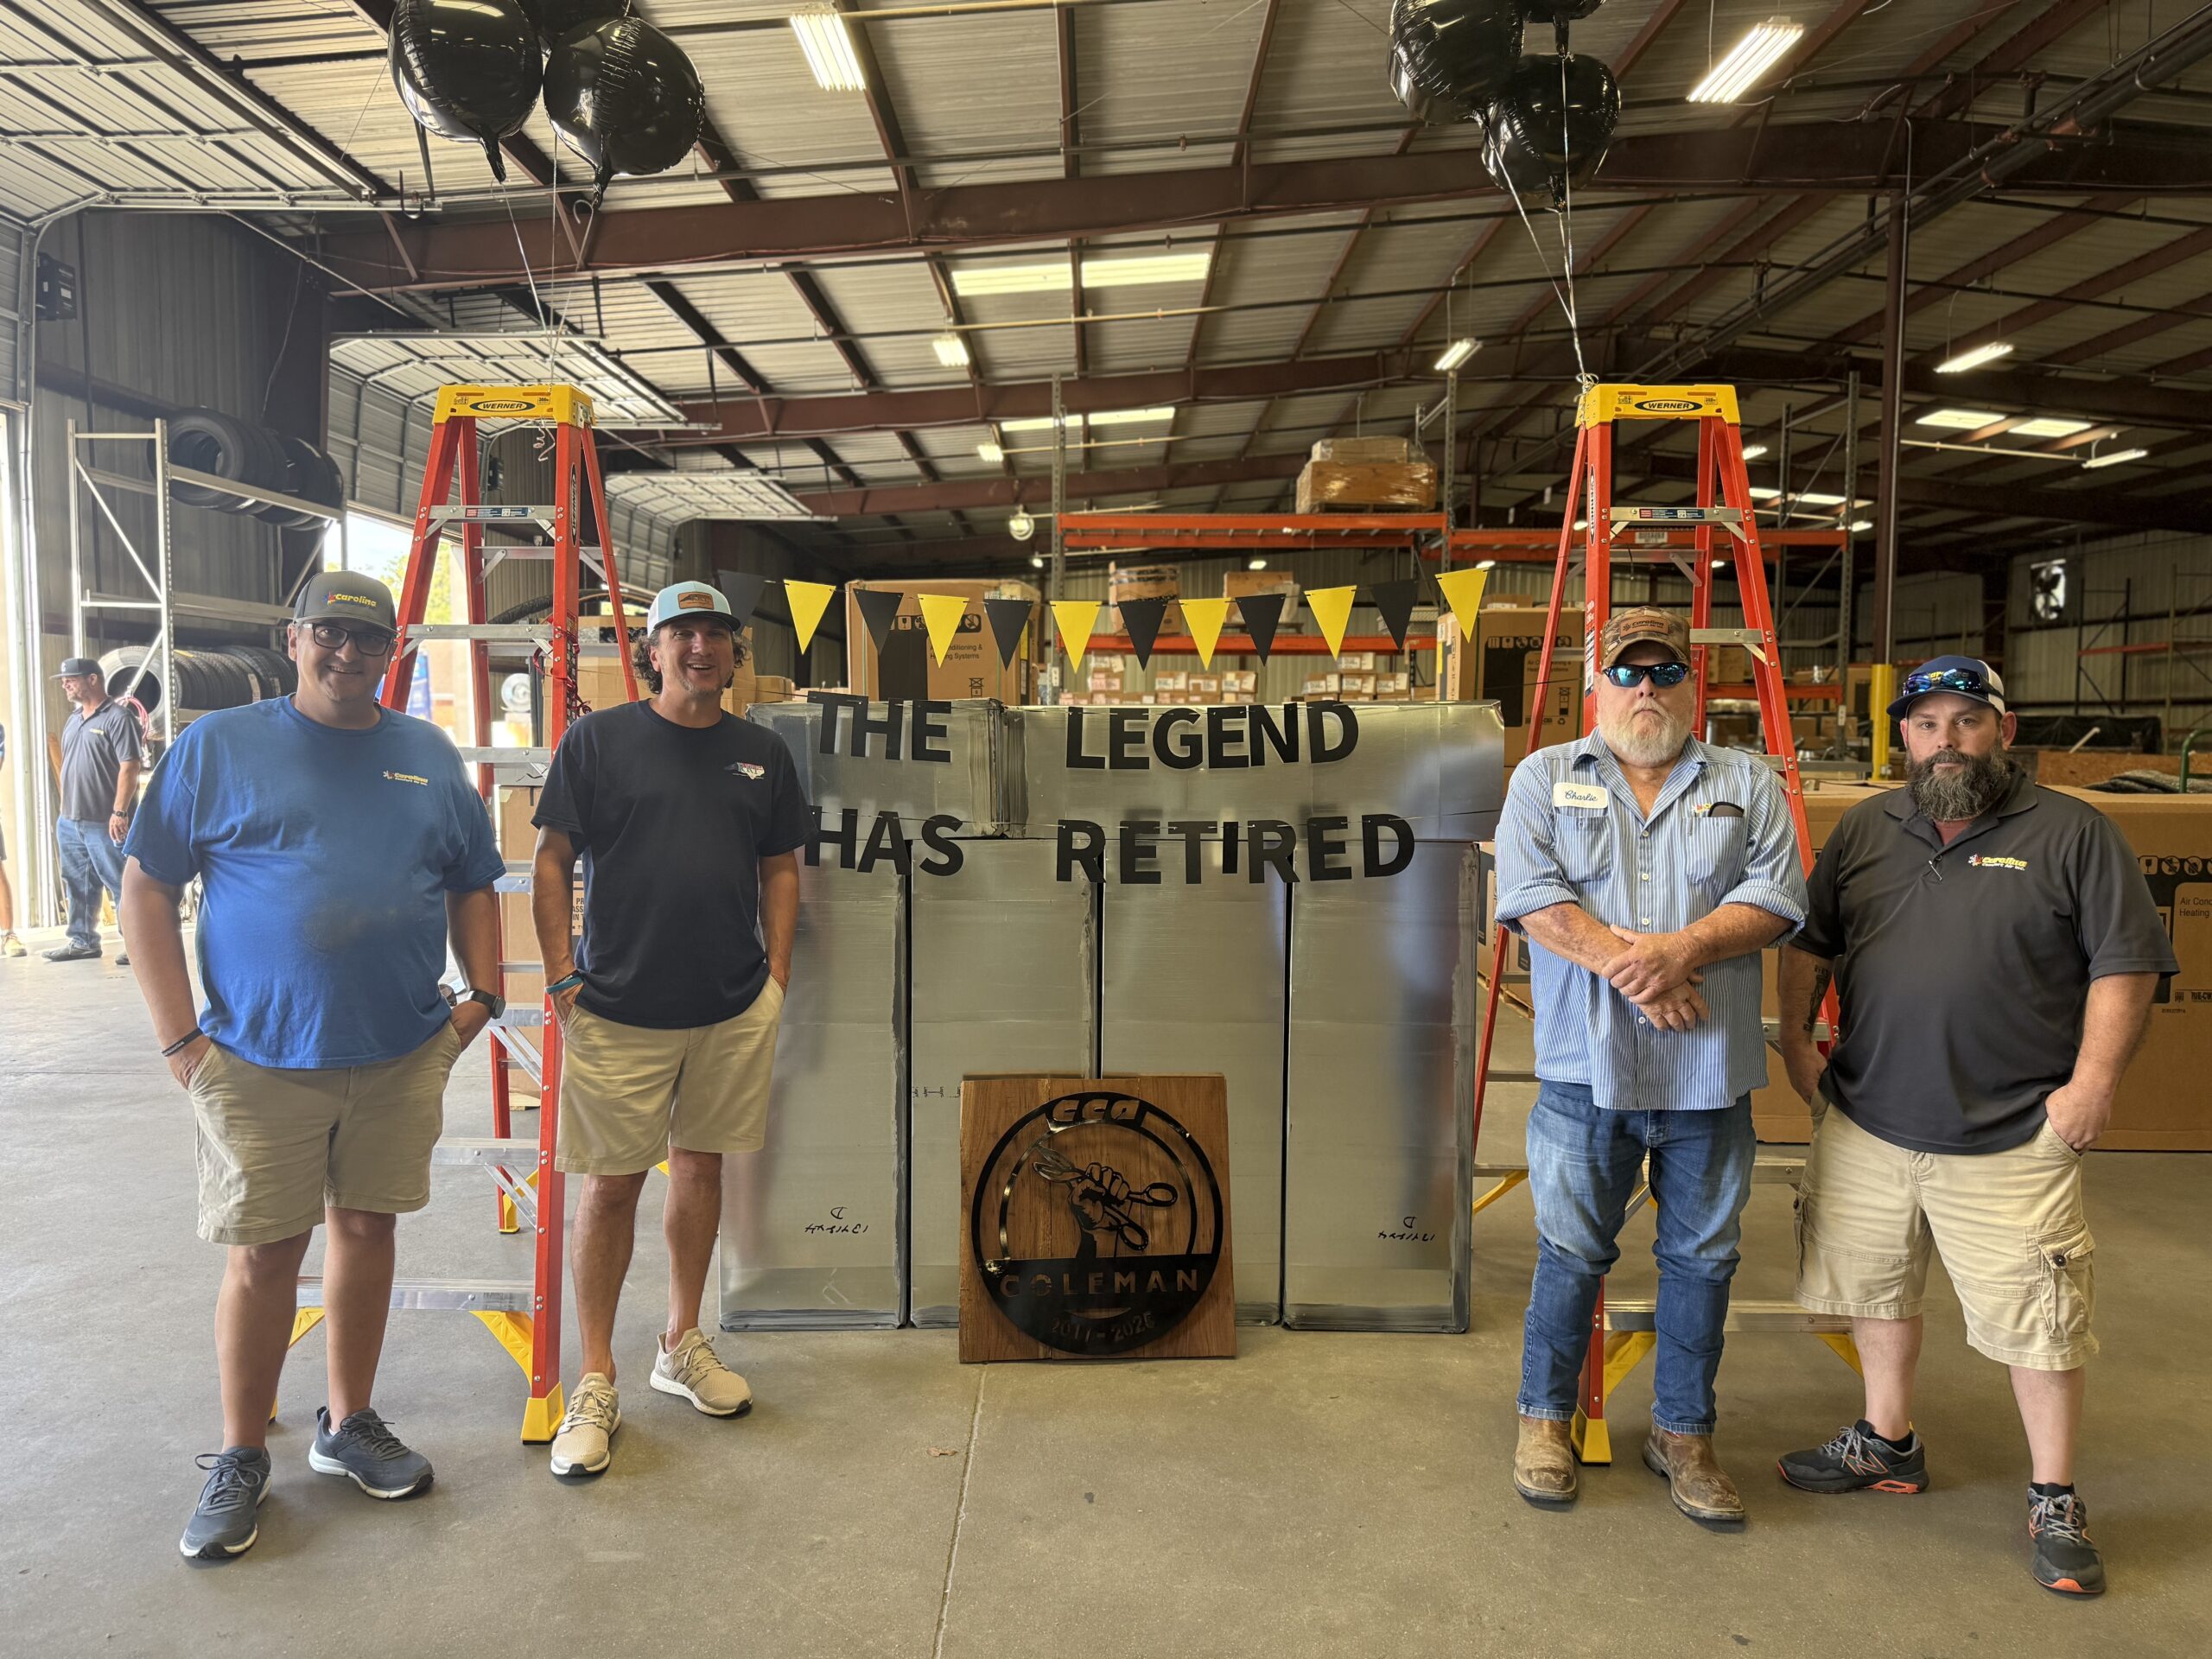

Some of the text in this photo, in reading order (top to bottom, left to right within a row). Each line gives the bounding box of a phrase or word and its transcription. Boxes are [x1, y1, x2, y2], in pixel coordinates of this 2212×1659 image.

[807, 691, 951, 763] THE
[1066, 701, 1359, 770] LEGEND
[1565, 790, 1599, 802] Charlie
[804, 805, 964, 876] HAS
[1056, 814, 1415, 885] RETIRED
[2179, 909, 2209, 918] Heating
[1000, 1269, 1198, 1297] COLEMAN
